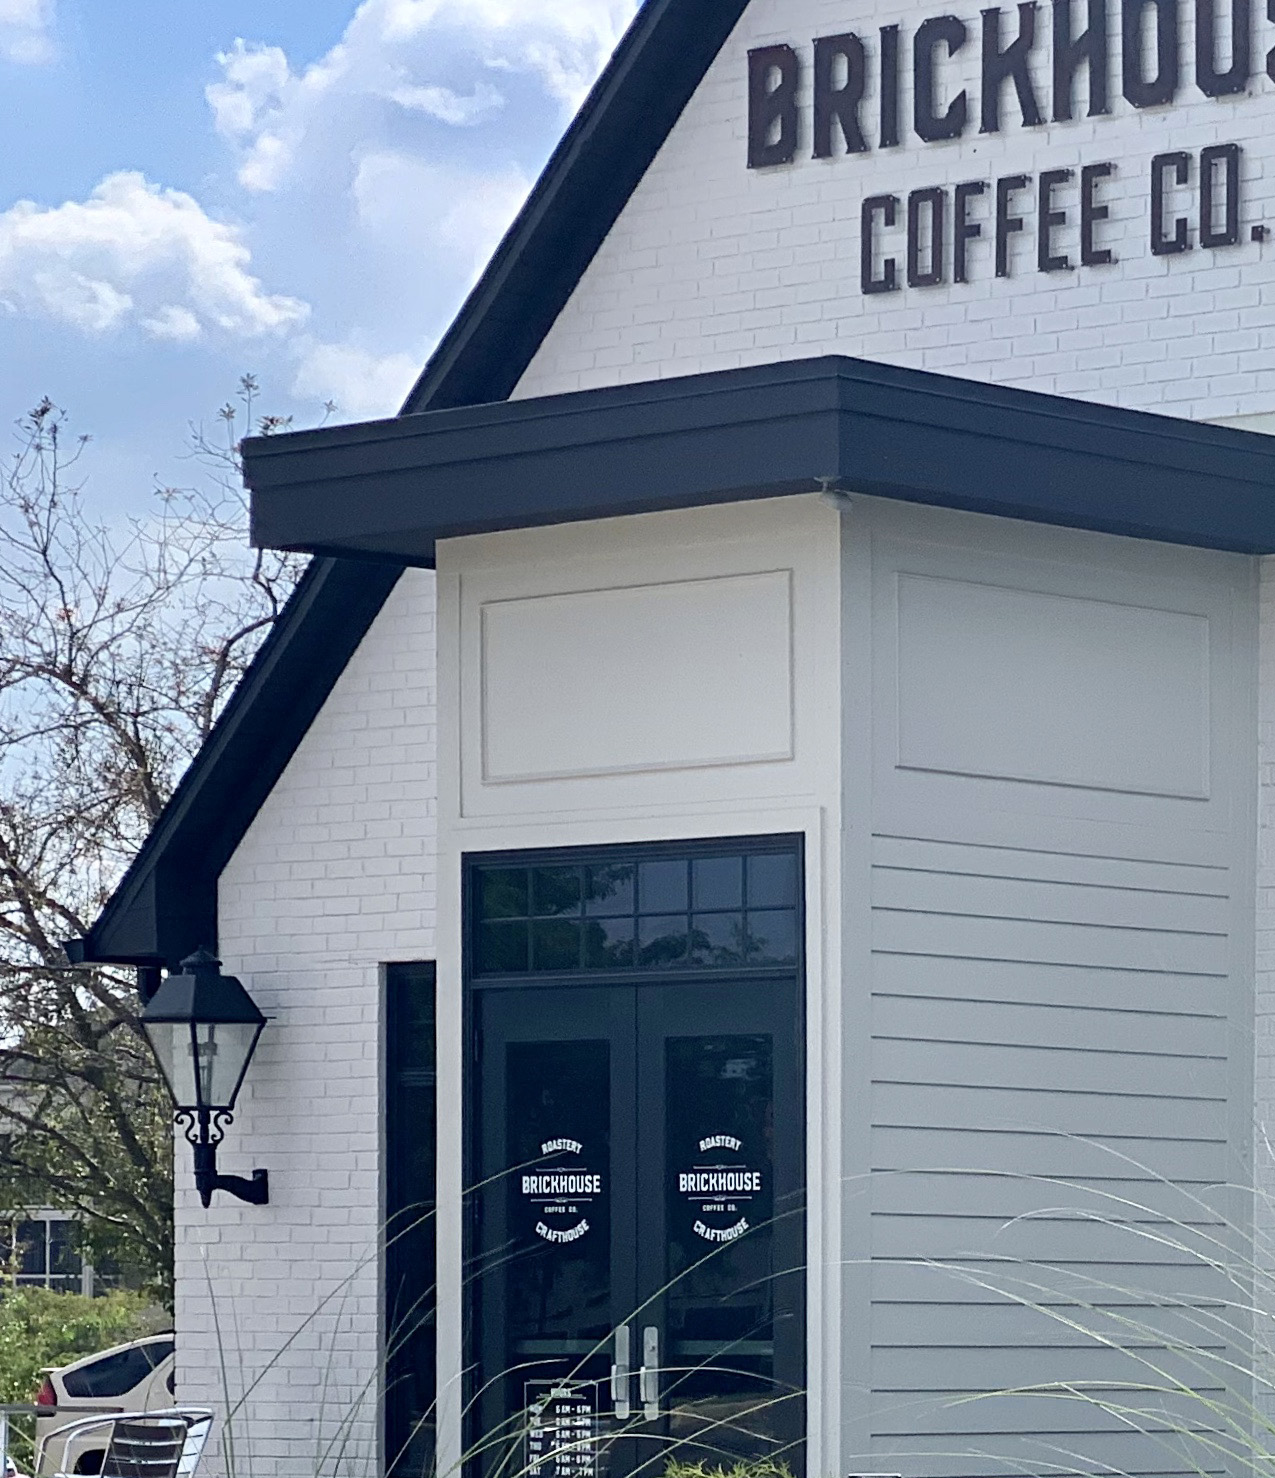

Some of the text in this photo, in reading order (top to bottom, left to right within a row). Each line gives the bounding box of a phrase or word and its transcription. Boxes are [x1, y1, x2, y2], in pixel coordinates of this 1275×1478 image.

[861, 143, 1266, 294] COFFEE CO.
[541, 1138, 583, 1155] ROASTERY
[699, 1135, 742, 1152] ROASTERY
[522, 1174, 601, 1194] BRICKHOUSE
[679, 1172, 761, 1192] BRICKHOUSE
[702, 1204, 725, 1212] COFFEE
[535, 1218, 590, 1243] CRAFTHOUSE
[693, 1217, 750, 1242] CRAFTHOUSE
